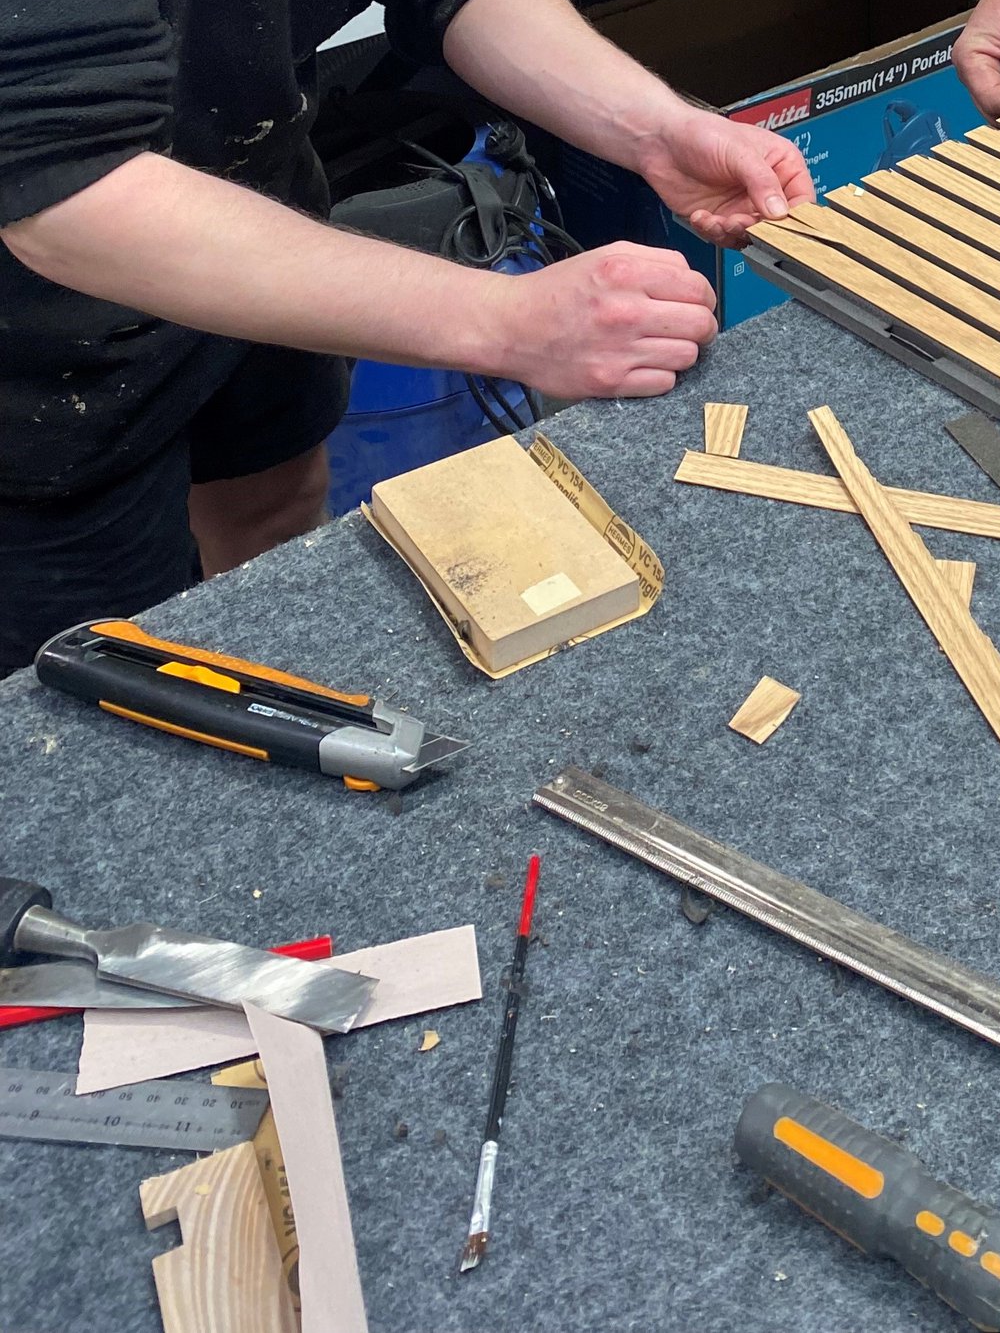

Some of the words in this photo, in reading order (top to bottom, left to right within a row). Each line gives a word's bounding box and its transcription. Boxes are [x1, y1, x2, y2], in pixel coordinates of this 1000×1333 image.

[755, 104, 810, 130] akita
[815, 62, 908, 110] 355mm(14")
[557, 455, 569, 475] VC
[569, 471, 584, 493] 154
[607, 525, 632, 555] HERMES
[638, 545, 652, 568] VC
[202, 1098, 217, 1108] 20
[103, 1115, 121, 1127] 10
[175, 1121, 190, 1133] 11
